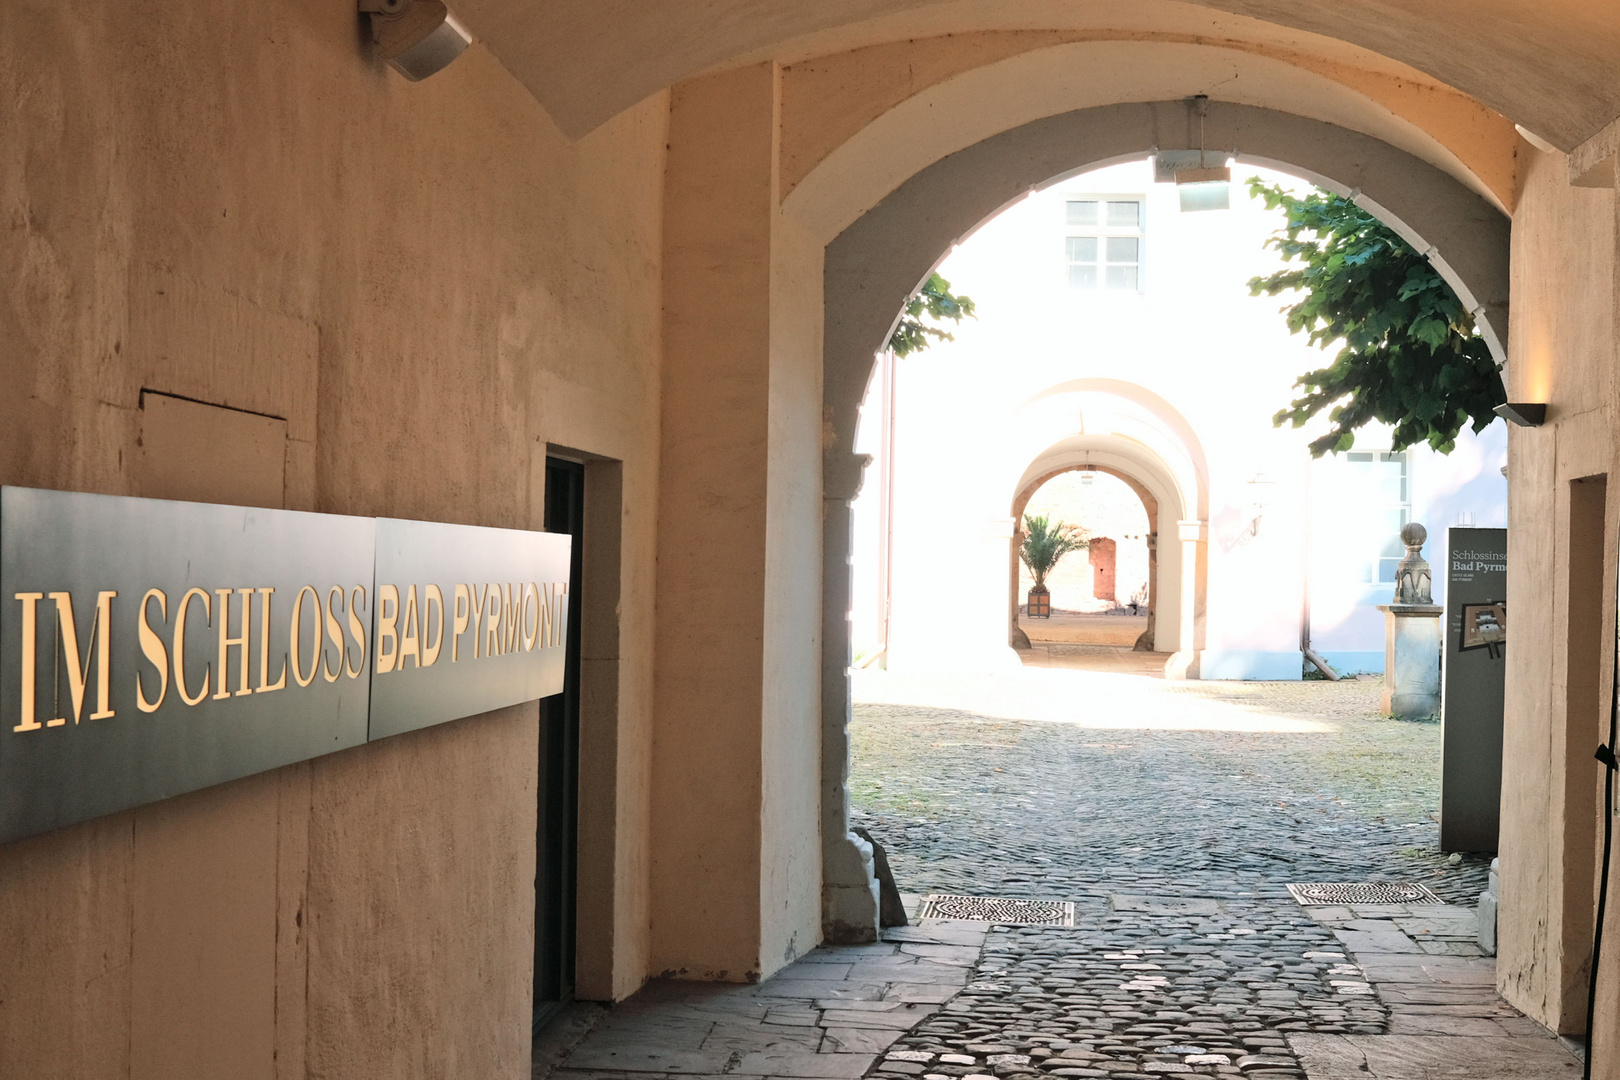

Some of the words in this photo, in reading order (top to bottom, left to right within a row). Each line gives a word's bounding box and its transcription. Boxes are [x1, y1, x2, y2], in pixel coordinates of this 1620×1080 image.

[1452, 561, 1474, 571] Bad
[1475, 561, 1507, 573] Pyrm
[13, 590, 118, 732] IM
[136, 584, 367, 713] SCHLOSS
[376, 584, 444, 674] BAD
[452, 581, 567, 662] PYRMONT
